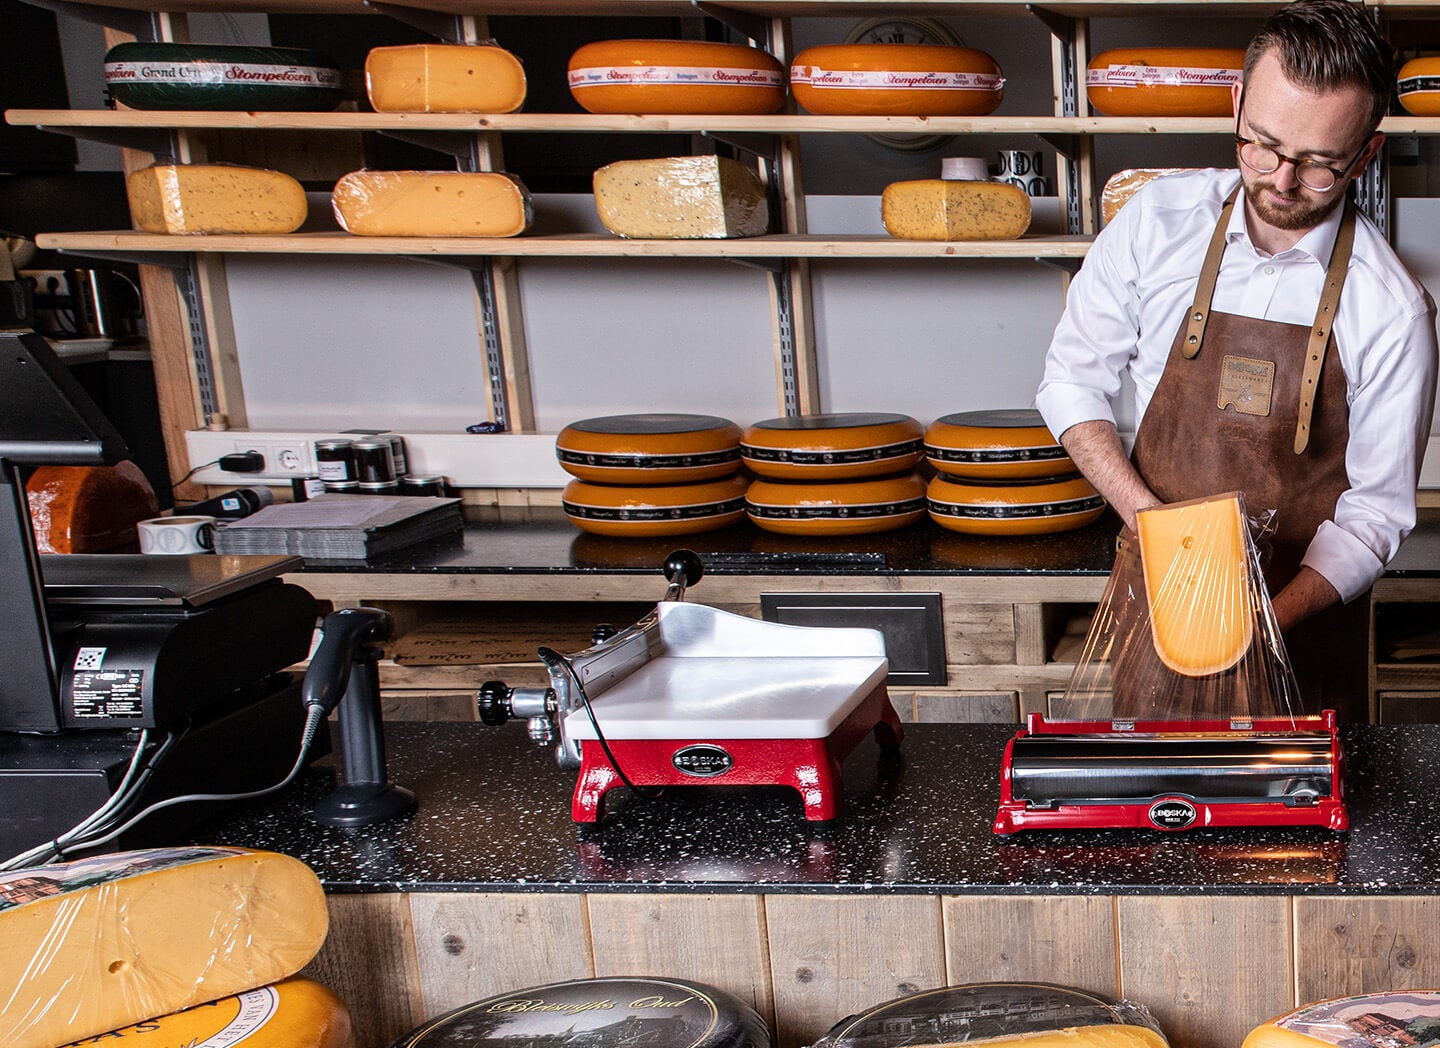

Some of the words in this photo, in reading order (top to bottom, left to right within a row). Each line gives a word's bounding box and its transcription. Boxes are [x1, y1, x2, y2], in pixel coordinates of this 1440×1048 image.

[142, 66, 176, 78] Grand
[225, 66, 311, 82] Stompetoren
[883, 74, 947, 87] Stompetoren
[1174, 68, 1240, 84] Stompetoren
[681, 755, 723, 767] BOSKA
[1158, 809, 1187, 818] BOSKA
[628, 996, 695, 1009] Oud
[243, 1003, 265, 1021] VAN
[216, 1024, 250, 1042] HET
